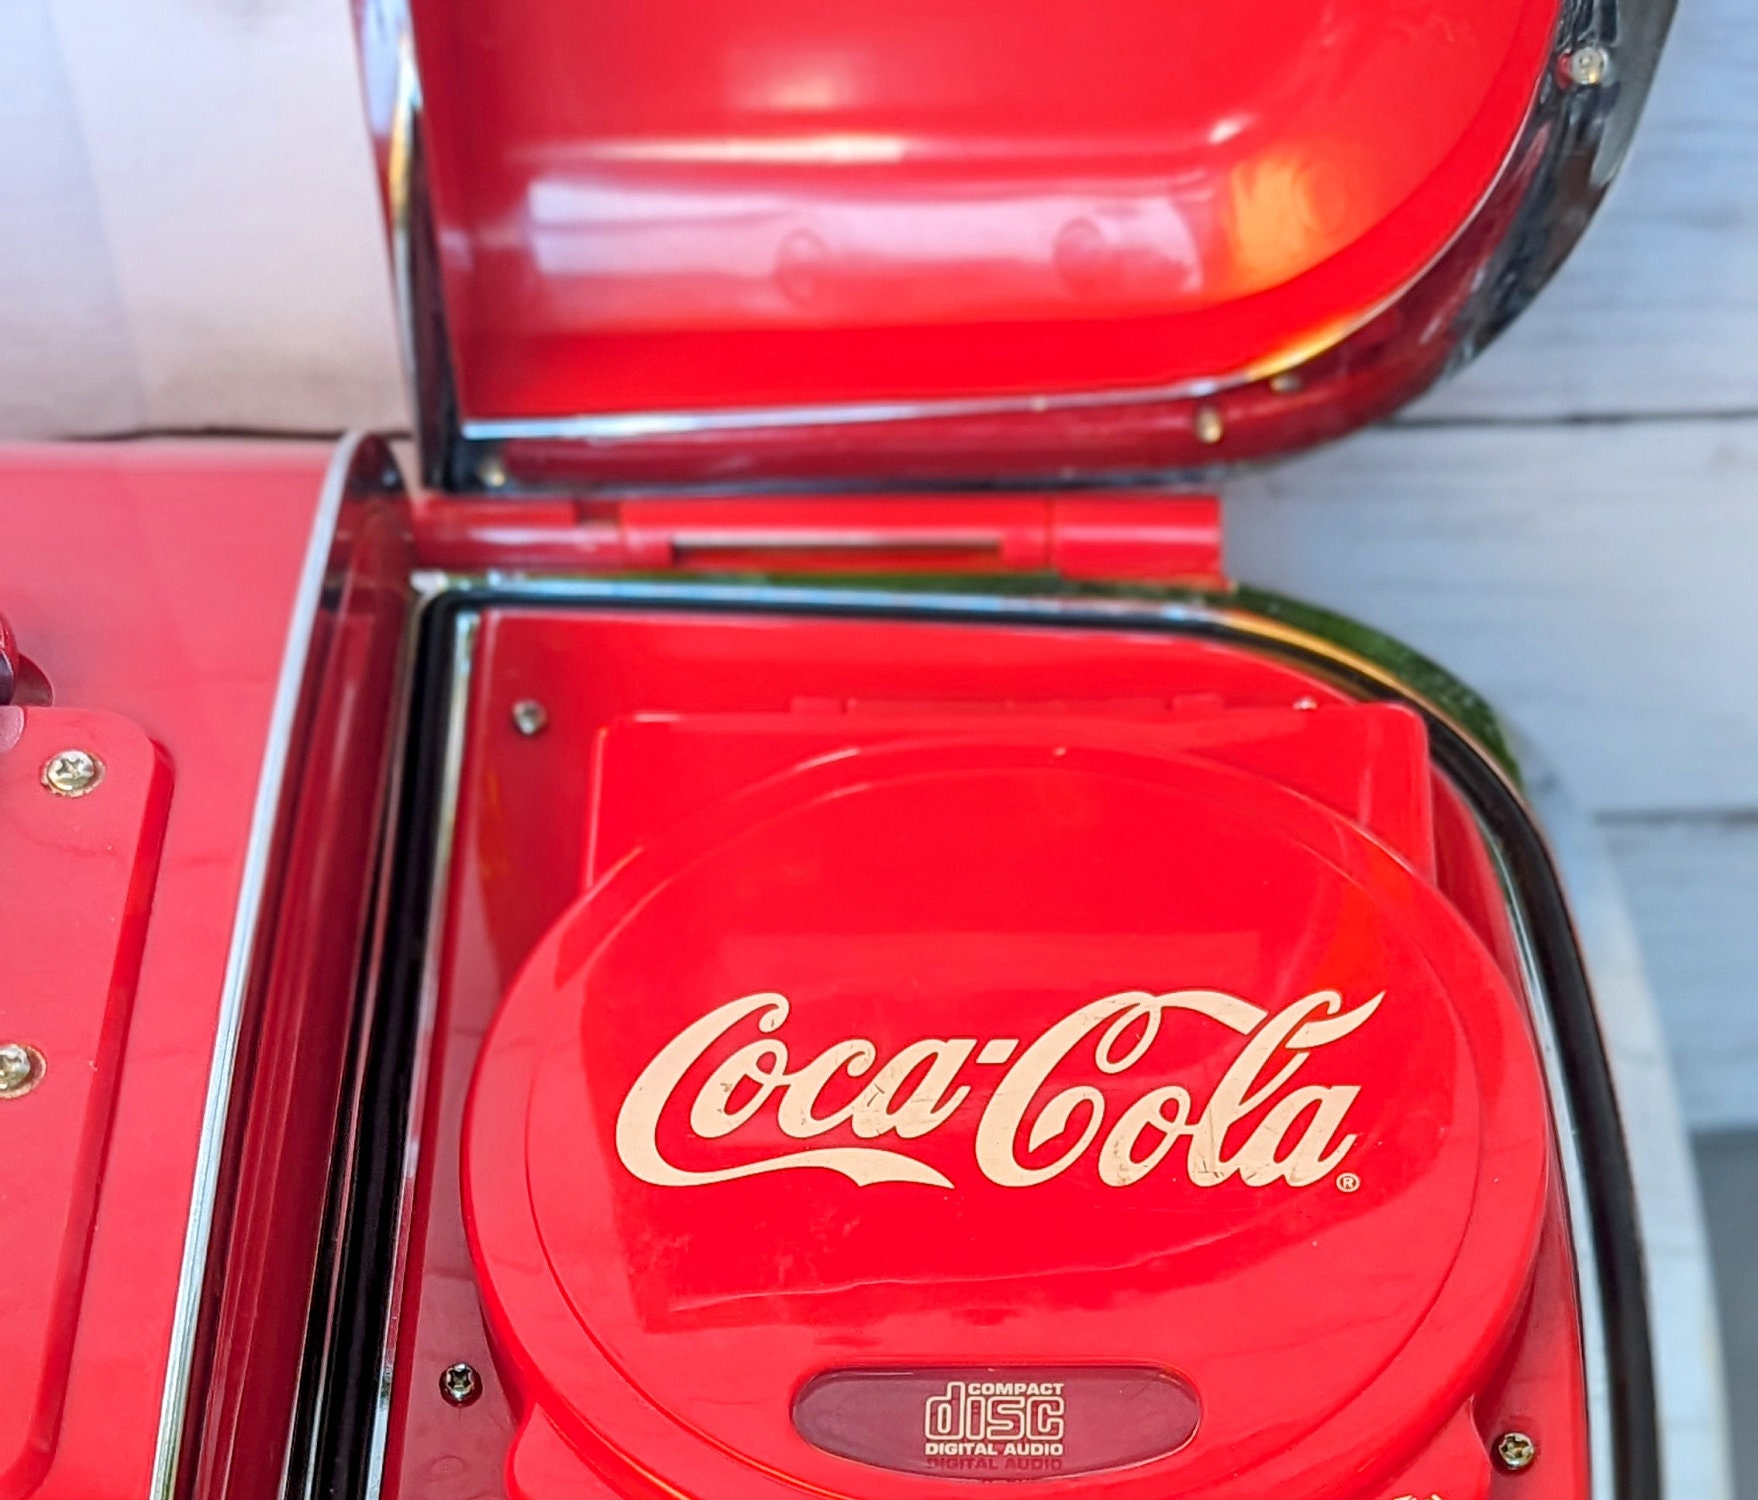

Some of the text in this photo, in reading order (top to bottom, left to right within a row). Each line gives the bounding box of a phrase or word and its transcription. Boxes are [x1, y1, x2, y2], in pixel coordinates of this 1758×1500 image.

[614, 989, 1387, 1189] Coca-Cola
[967, 1382, 1065, 1396] COMPACT
[924, 1442, 1064, 1456] DIGITAL AUDIO
